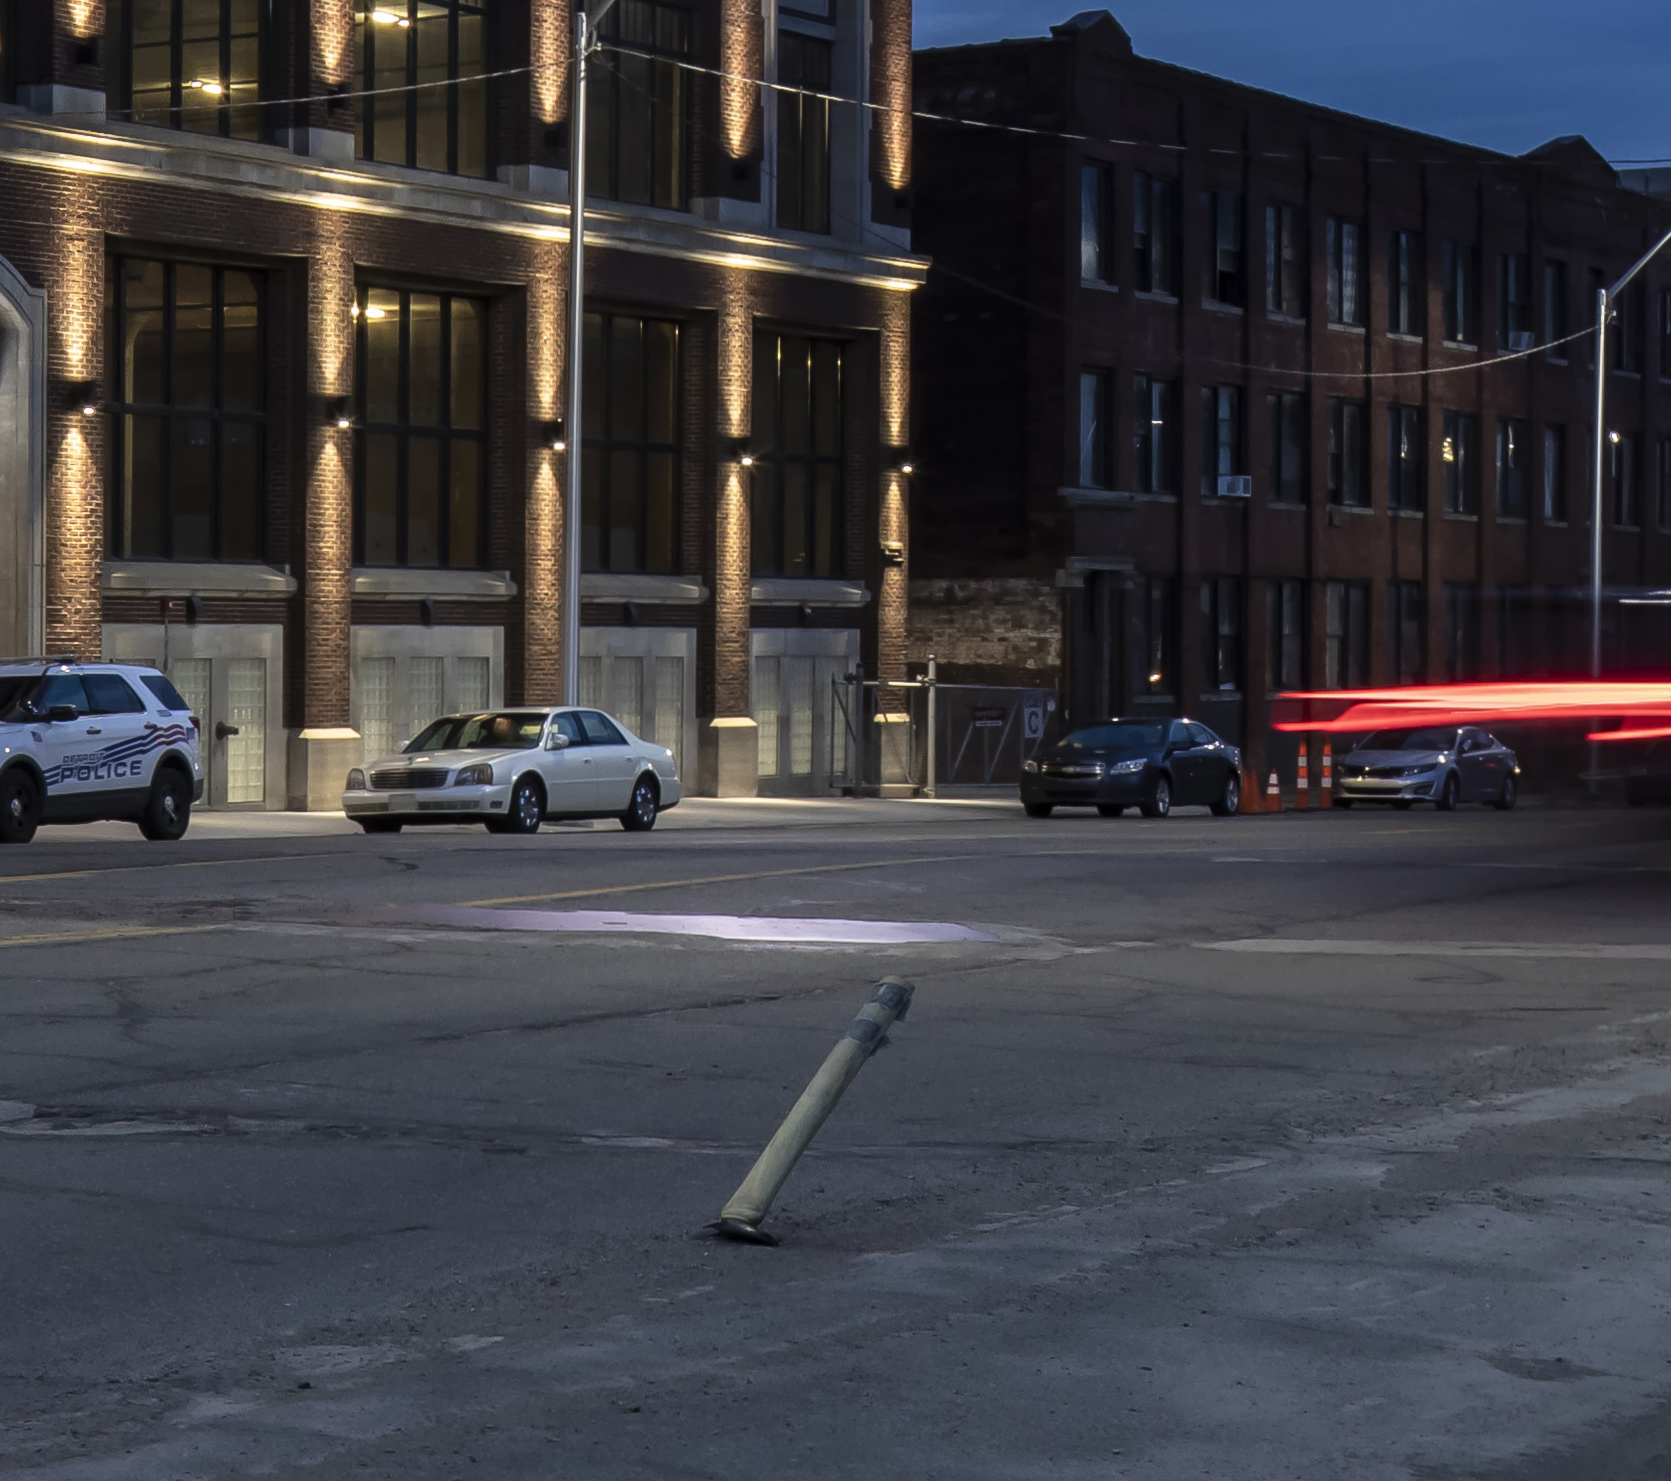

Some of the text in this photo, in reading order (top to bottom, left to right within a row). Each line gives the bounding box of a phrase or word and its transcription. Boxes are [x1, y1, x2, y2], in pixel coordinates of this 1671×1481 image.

[1027, 710, 1040, 734] C
[62, 752, 105, 764] DETROIT
[60, 759, 143, 783] POLICE
